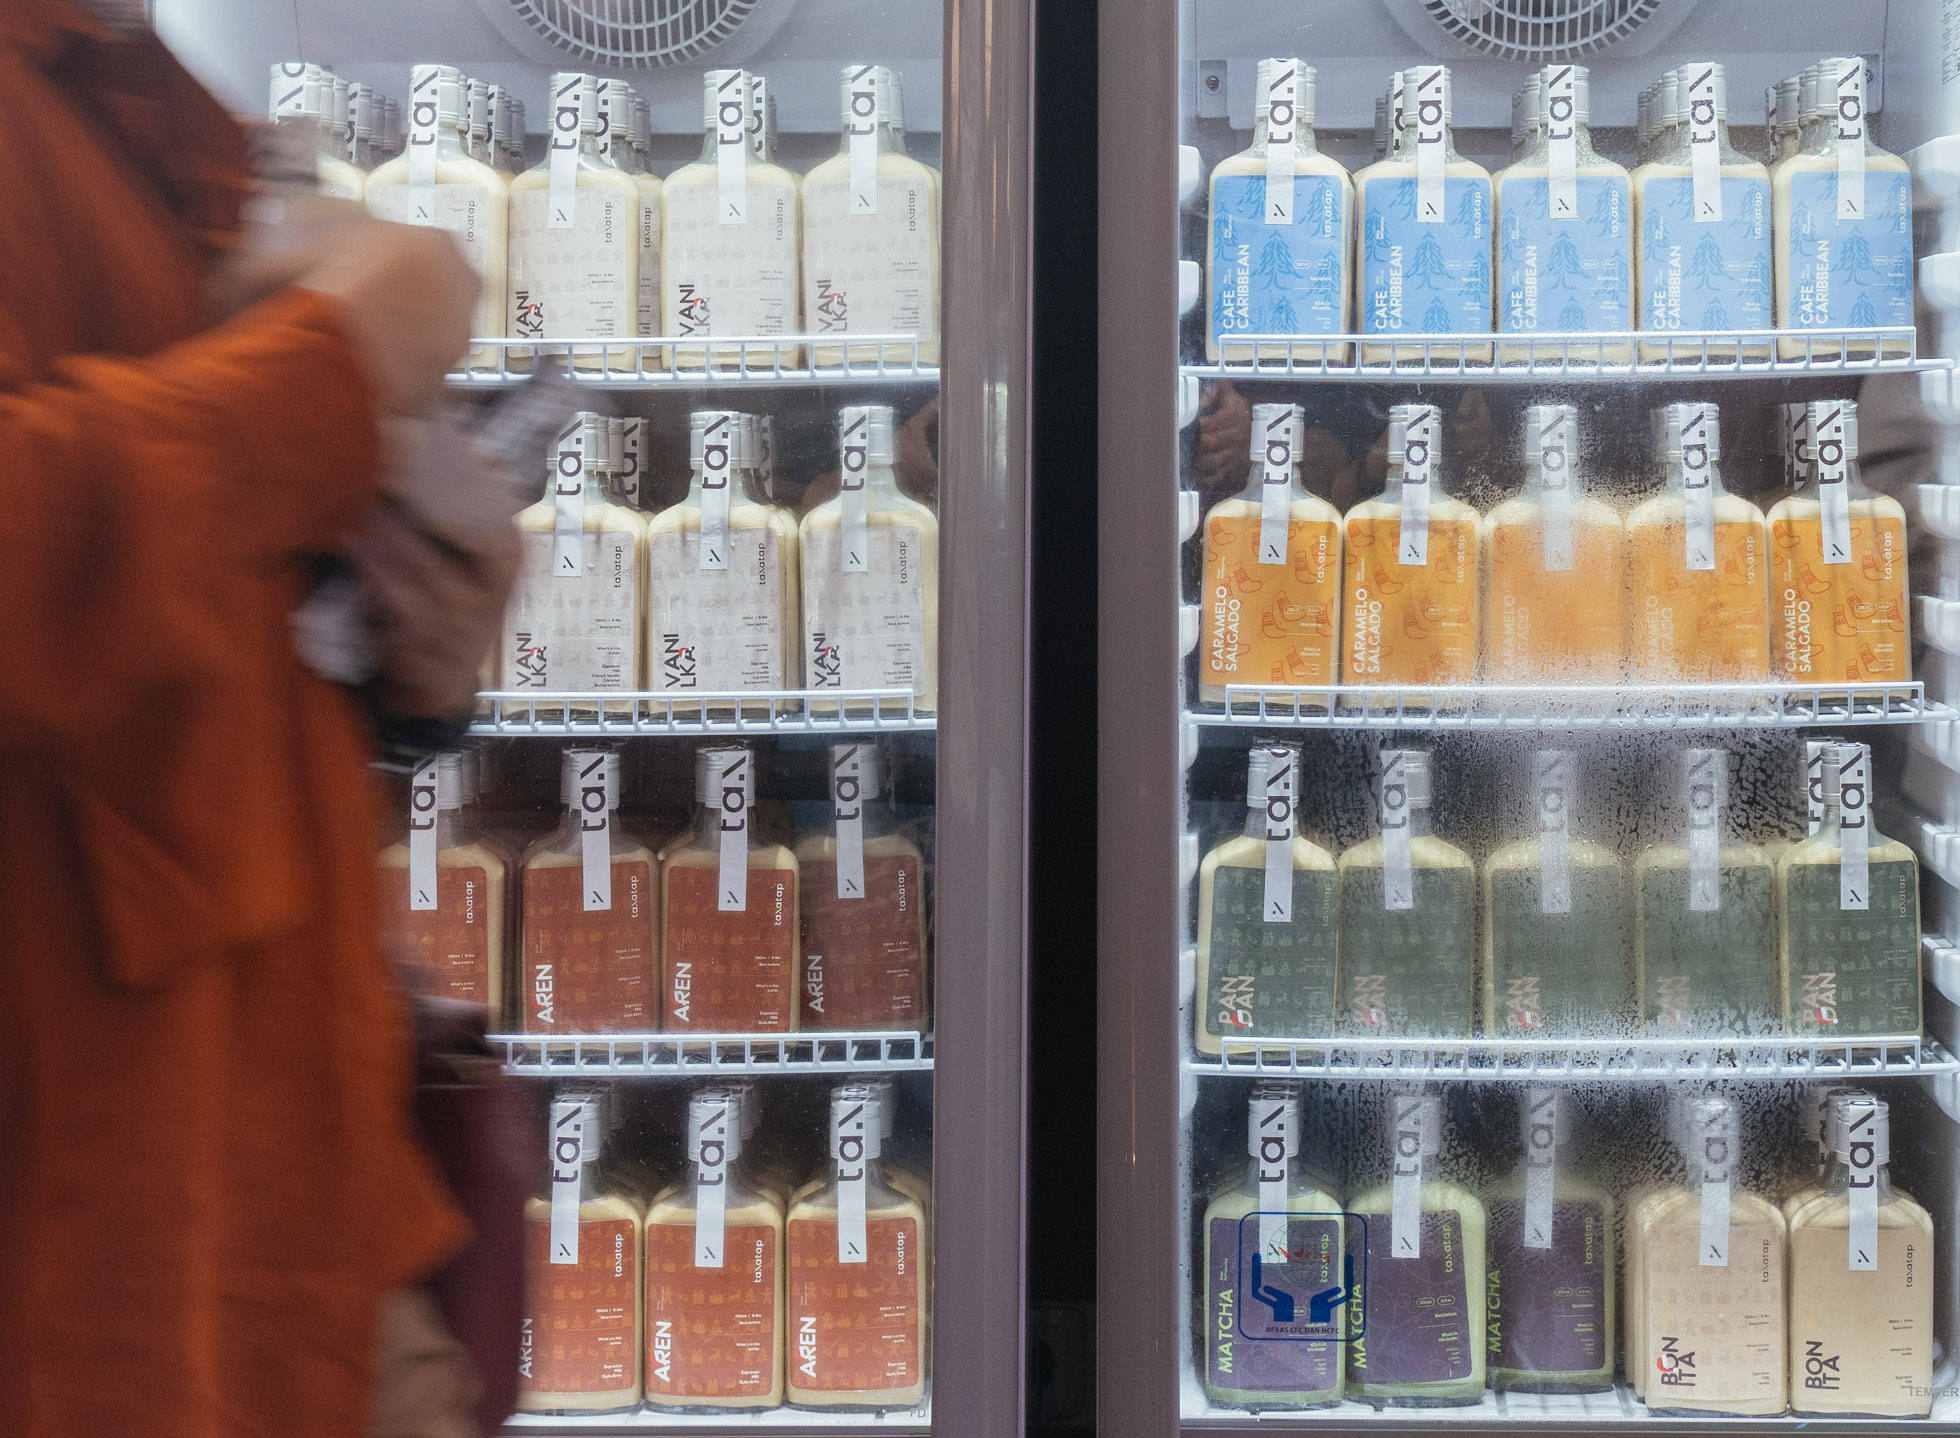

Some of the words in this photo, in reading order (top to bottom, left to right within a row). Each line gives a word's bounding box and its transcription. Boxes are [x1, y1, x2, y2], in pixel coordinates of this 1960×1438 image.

[679, 284, 695, 338] VANI
[816, 279, 832, 334] VANI
[1222, 290, 1235, 330] CAFE
[1237, 244, 1250, 330] CARIBBEAN
[1375, 290, 1388, 330] CAFE
[1389, 245, 1402, 330] CARIBBEAN
[1511, 290, 1524, 330] CAFE
[1525, 245, 1538, 330] CARIBBEAN
[1653, 290, 1667, 330] CAFE
[1668, 245, 1682, 330] CARIBBEAN
[1800, 284, 1814, 325] CAFE
[1815, 240, 1830, 325] CARIBBEAN
[516, 290, 529, 339] VANI
[529, 302, 544, 339] KA
[1212, 586, 1227, 671] CARAMELO
[1226, 599, 1241, 672] SALGADO
[1353, 588, 1367, 673] CARAMELO
[1368, 601, 1382, 673] SALGADO
[1784, 588, 1796, 673] CARAMELO
[1799, 600, 1812, 673] SALGADO
[516, 632, 532, 687] VANI
[663, 633, 680, 688] VANI
[812, 632, 827, 688] VANI
[536, 964, 554, 1024] AREN
[674, 962, 692, 1022] AREN
[808, 955, 824, 1013] AREN
[1219, 976, 1238, 1024] PAN
[1802, 974, 1819, 1023] PAN
[1218, 1288, 1234, 1374] MATCHA
[1350, 1283, 1367, 1369] MATCHA
[1487, 1270, 1502, 1353] MATCHA
[518, 1318, 533, 1379] AREN
[655, 1321, 671, 1382] AREN
[800, 1316, 816, 1377] AREN
[1661, 1336, 1678, 1386] BON
[1679, 1351, 1695, 1386] ITA
[1805, 1340, 1823, 1389] BON
[1823, 1355, 1840, 1390] ITA
[1910, 1386, 1959, 1397] TEMPER
